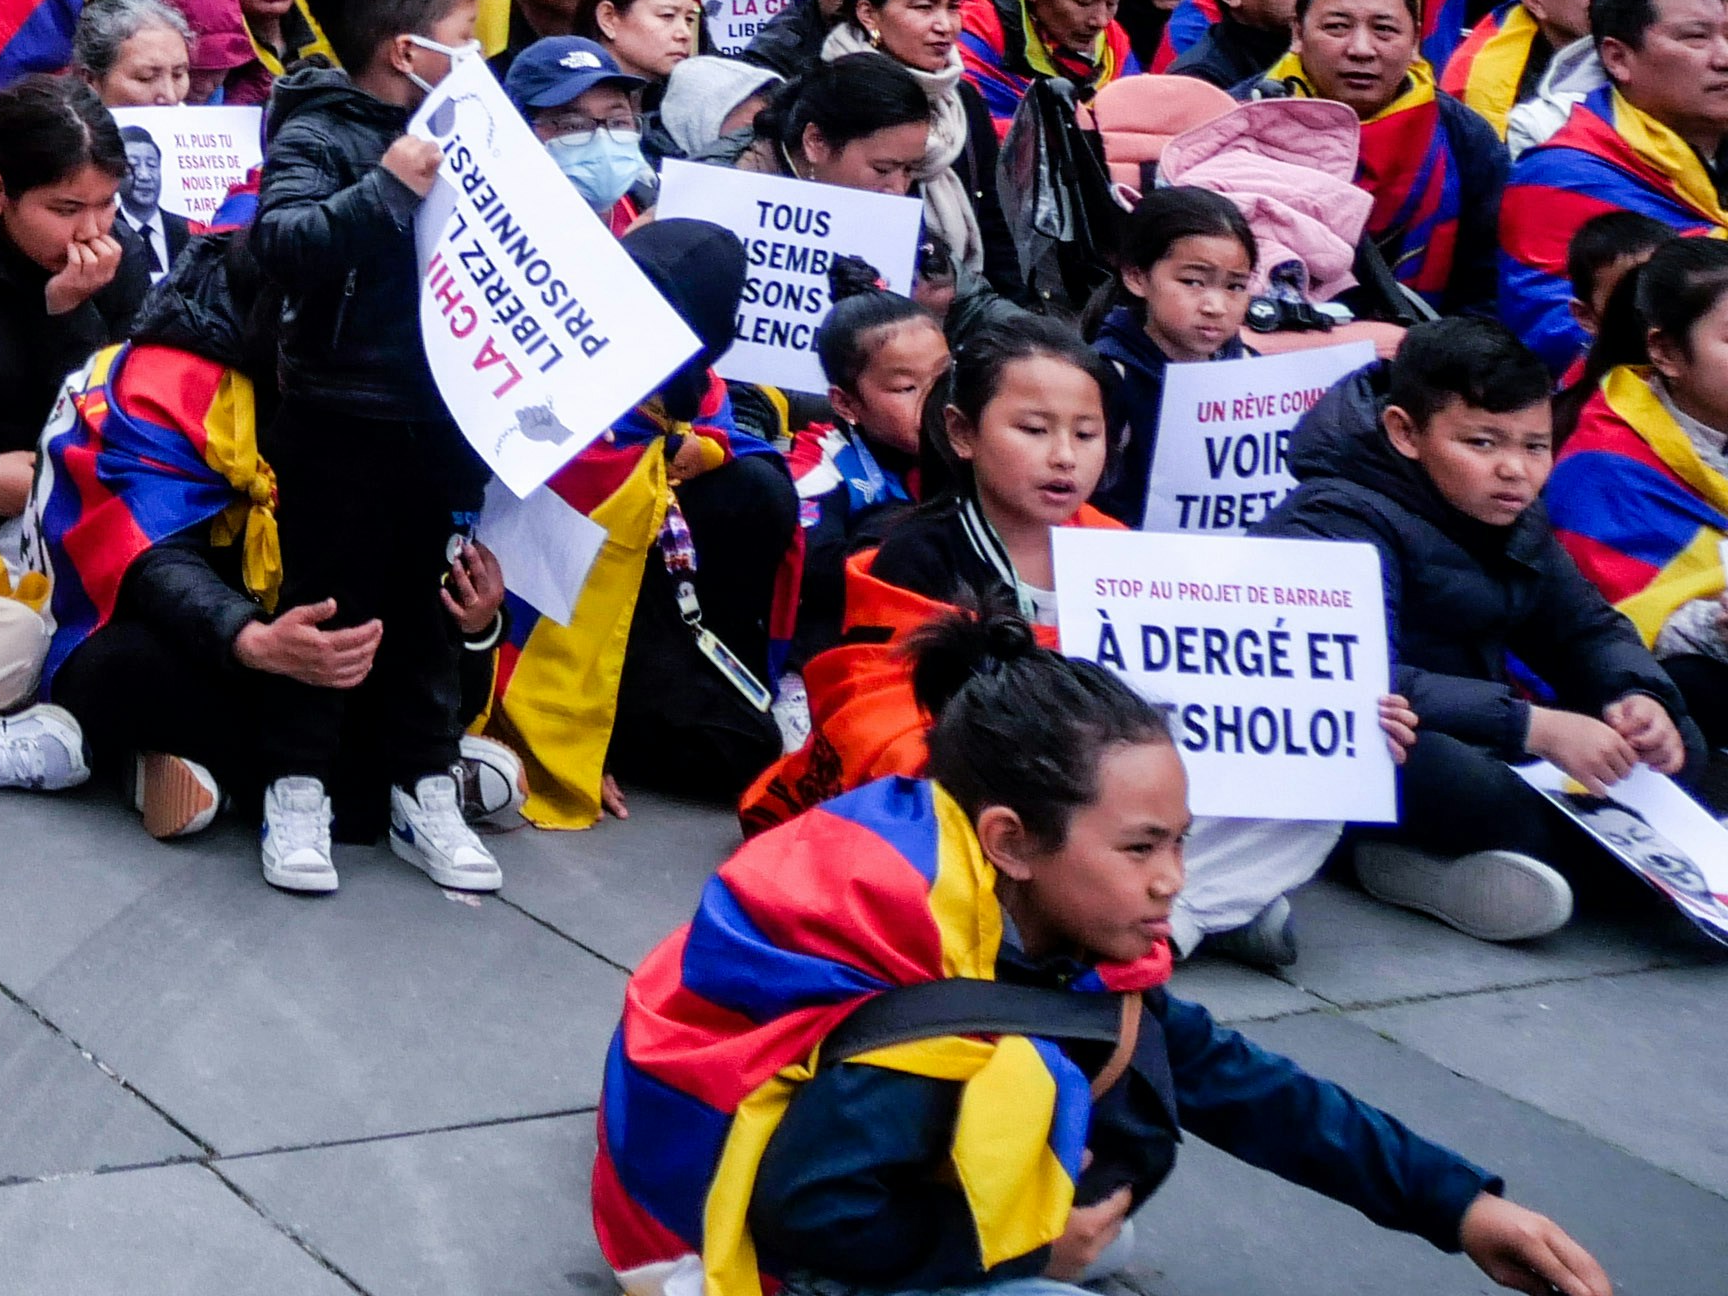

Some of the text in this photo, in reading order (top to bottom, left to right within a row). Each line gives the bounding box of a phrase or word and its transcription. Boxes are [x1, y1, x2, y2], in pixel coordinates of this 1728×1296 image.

[732, 0, 758, 16] LA
[190, 134, 217, 148] PLUS
[218, 134, 232, 148] TU
[178, 155, 241, 169] ESSAYES DE
[181, 176, 212, 191] NOUS
[185, 198, 217, 212] TAIRE
[757, 200, 832, 238] TOUS
[442, 135, 610, 359] PRISONNIERS!
[744, 237, 830, 276] SEMB
[458, 239, 564, 373] LIBÉREZ
[741, 277, 824, 314] SONS
[425, 252, 523, 400] LA CHI
[735, 314, 823, 353] LENC
[1197, 400, 1226, 423] UN
[1232, 392, 1277, 421] RÊVE
[1175, 491, 1277, 529] TIBET
[1095, 578, 1353, 609] STOP AU PROJET DE BARRAGE
[1096, 608, 1359, 681] À DERGÉ ET
[1156, 702, 1356, 758] SHOLO!
